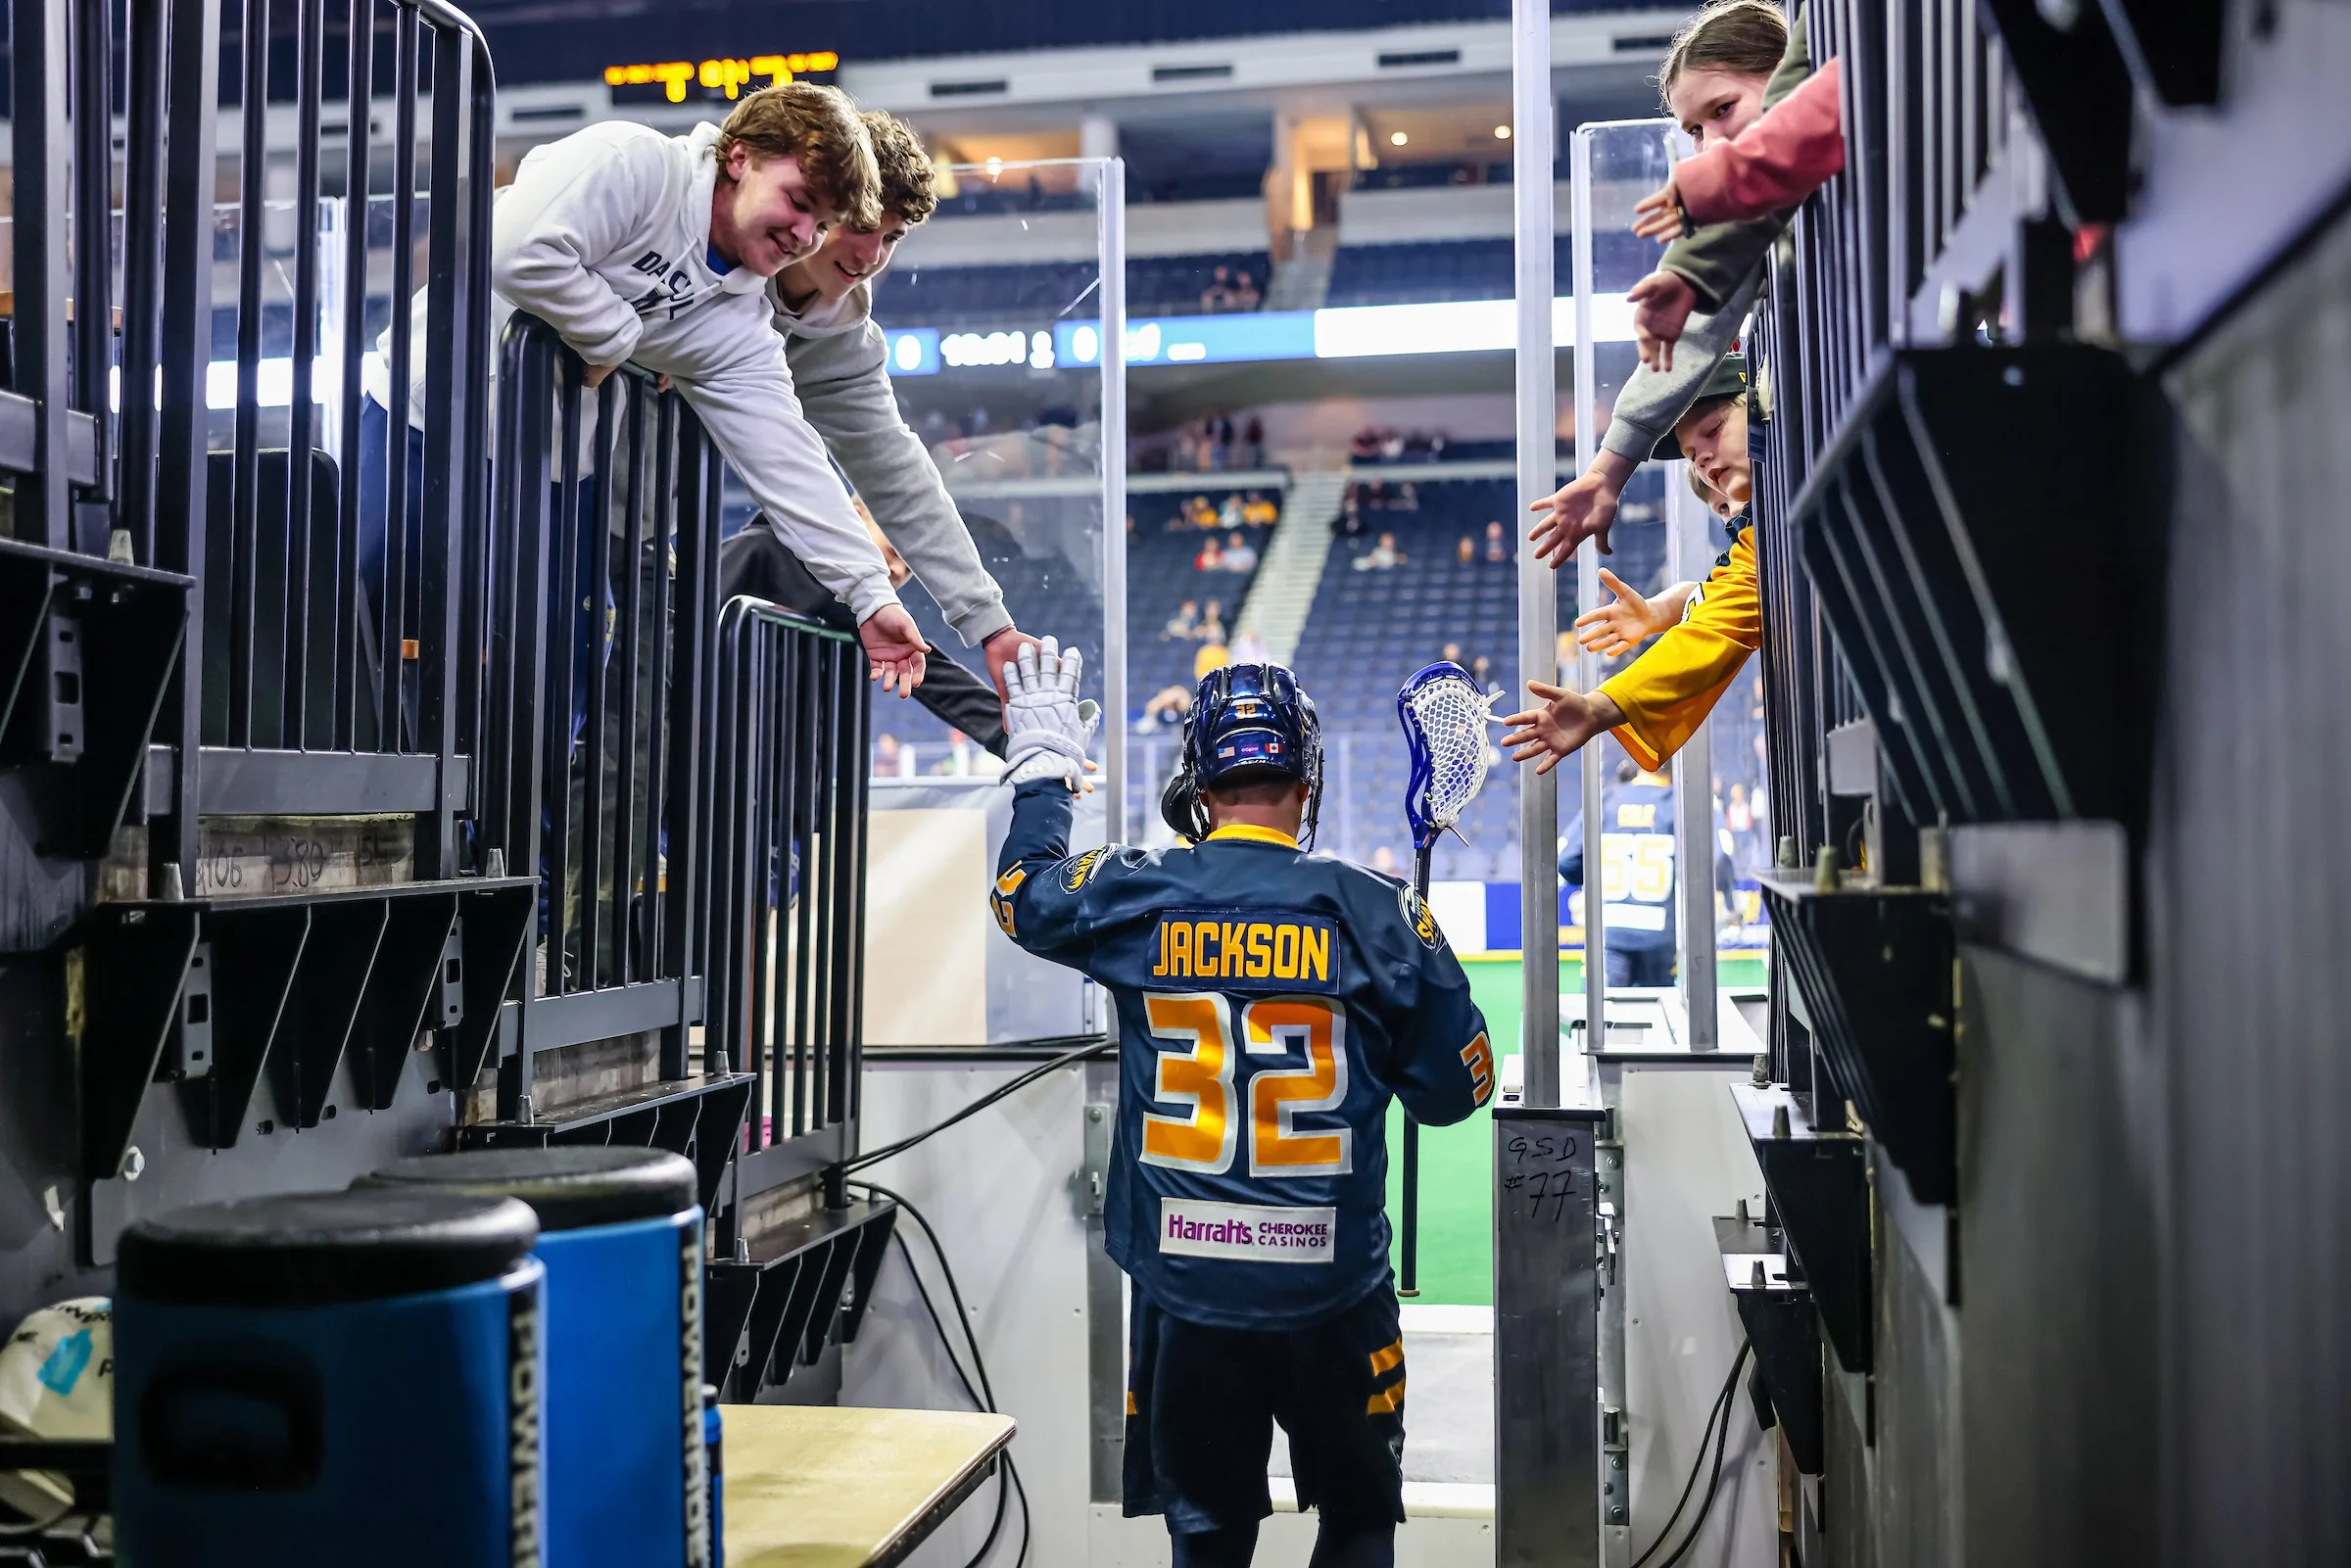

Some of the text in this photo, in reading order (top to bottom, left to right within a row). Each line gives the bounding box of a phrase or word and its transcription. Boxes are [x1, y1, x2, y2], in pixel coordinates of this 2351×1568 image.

[1153, 922, 1329, 981] JACKSON
[1139, 991, 1353, 1178] 32
[1258, 1235, 1326, 1247] CASINOS
[1259, 1222, 1327, 1236] CHEROKEE
